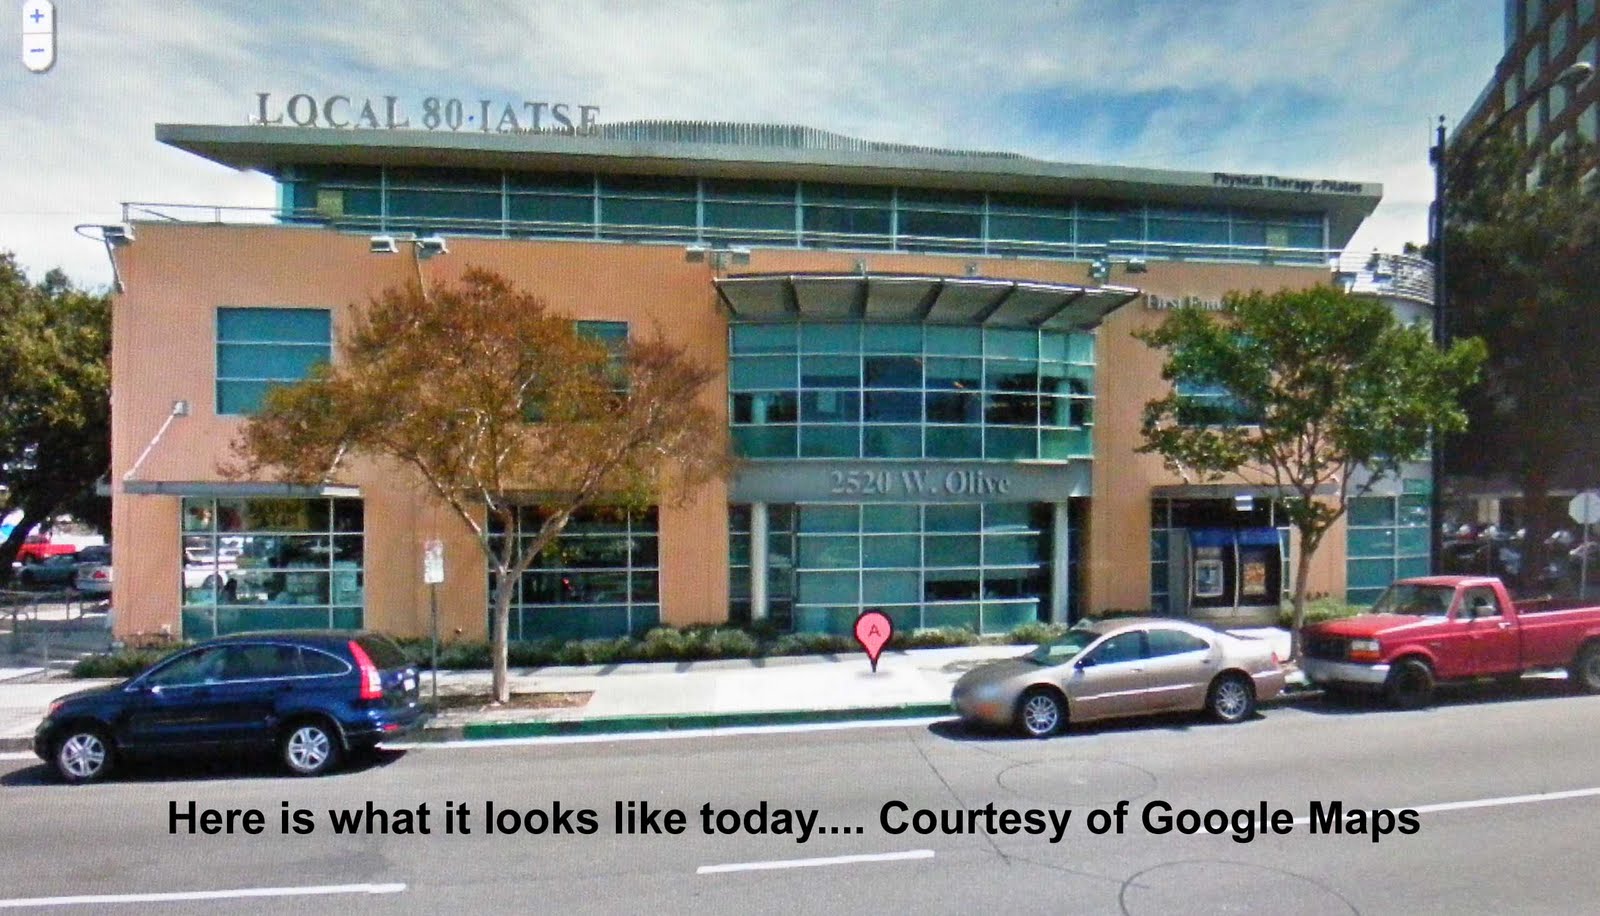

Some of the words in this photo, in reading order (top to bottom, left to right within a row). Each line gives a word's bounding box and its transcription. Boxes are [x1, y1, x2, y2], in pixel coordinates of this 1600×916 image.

[256, 93, 410, 129] LOCAL
[830, 470, 892, 494] 2520
[901, 470, 938, 494] W.
[945, 467, 1011, 495] Olive
